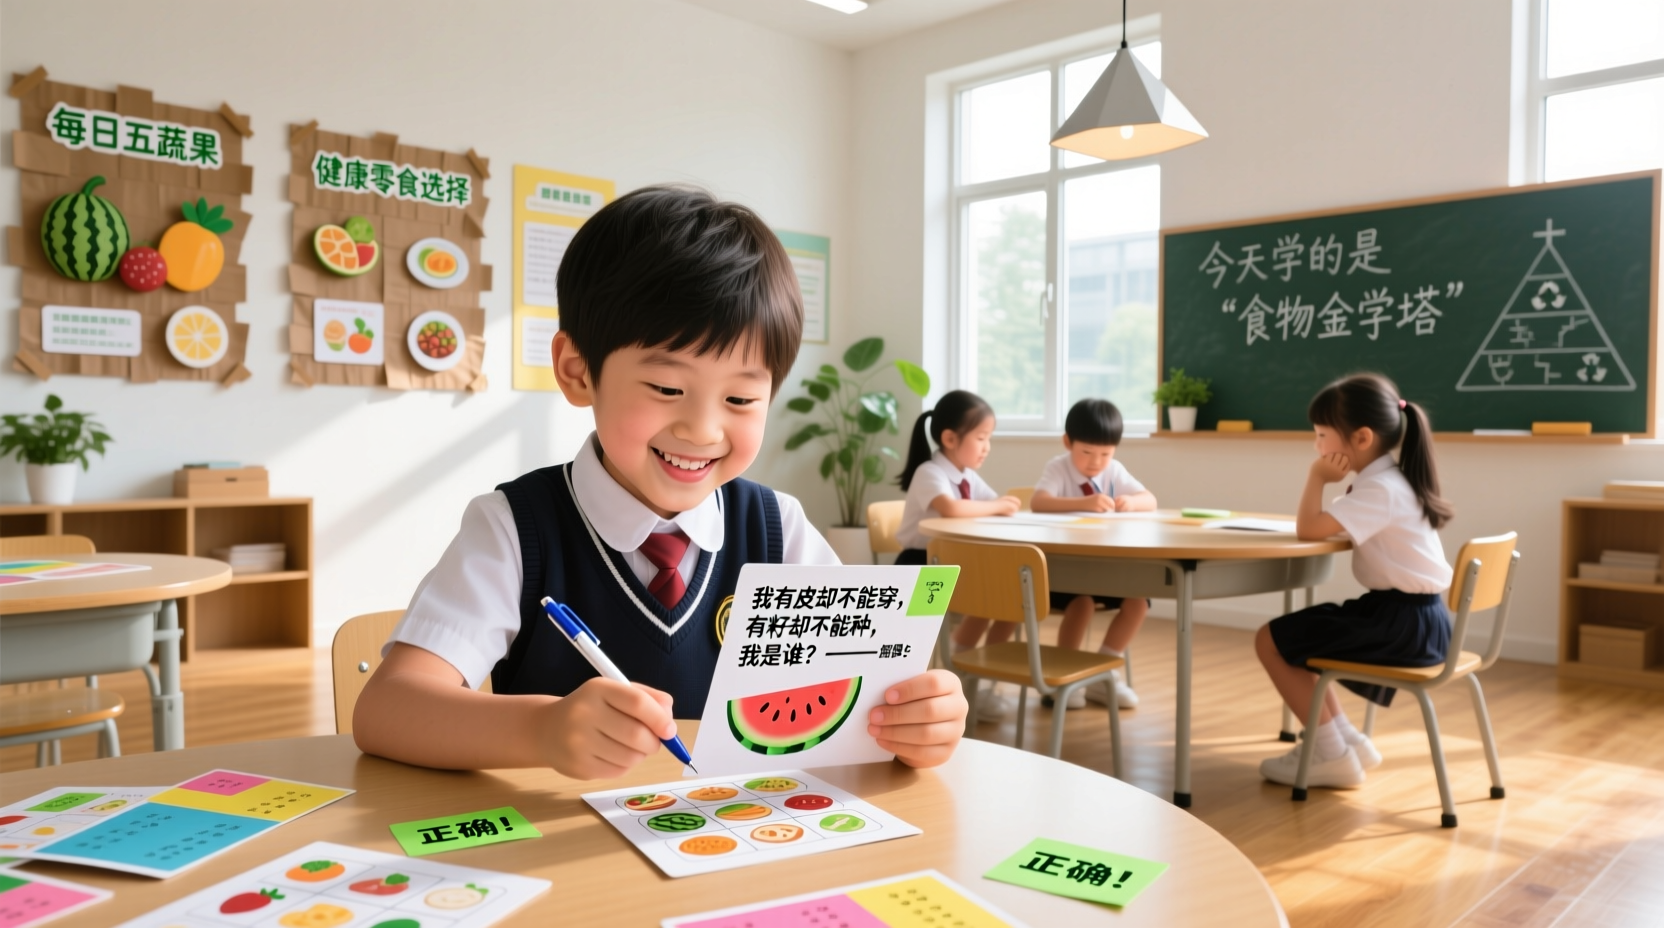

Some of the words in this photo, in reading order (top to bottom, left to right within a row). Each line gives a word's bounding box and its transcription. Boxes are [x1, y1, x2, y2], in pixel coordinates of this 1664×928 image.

[52, 107, 219, 165] 每日五蔬果
[316, 153, 471, 205] 健康零食选择
[1198, 228, 1392, 289] 今天学的是
[1221, 281, 1464, 346] “食物金学塔”
[752, 585, 904, 611] 我有皮却不能穿，
[416, 815, 514, 846] 正确！
[1019, 850, 1133, 890] 正确！
